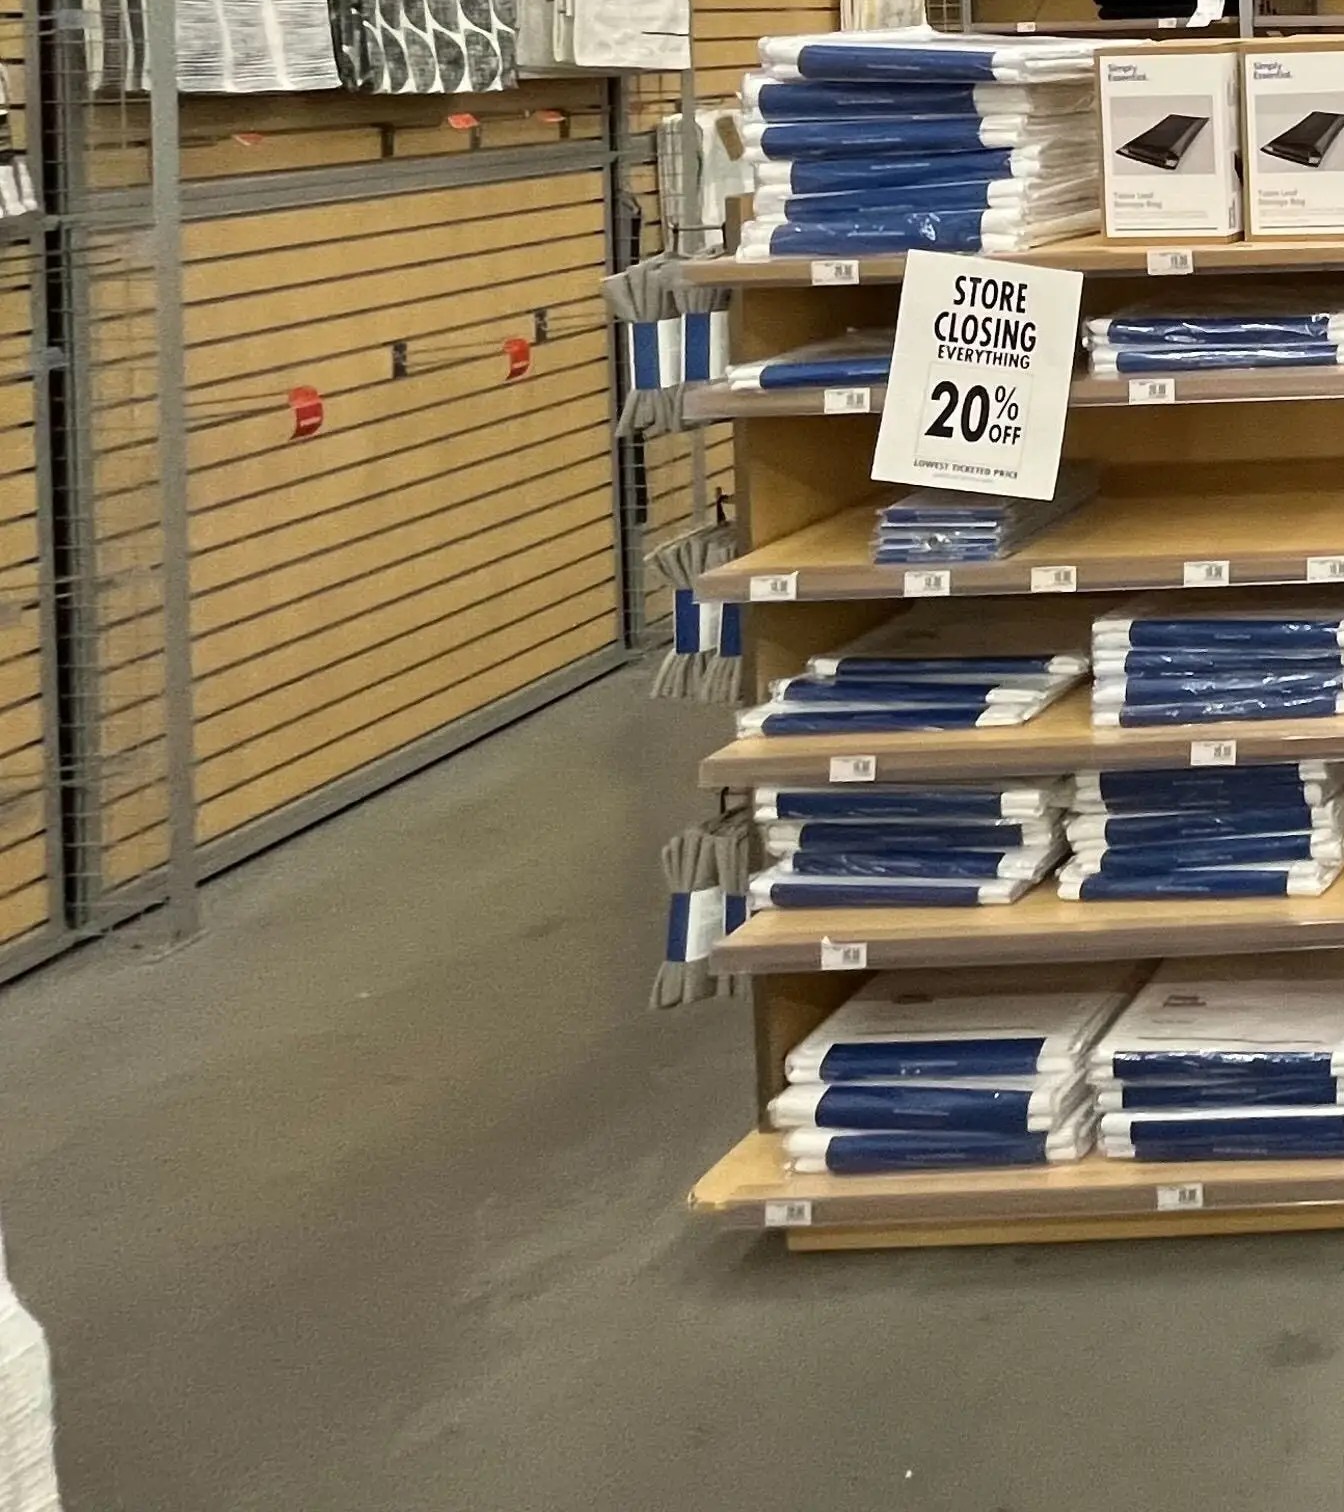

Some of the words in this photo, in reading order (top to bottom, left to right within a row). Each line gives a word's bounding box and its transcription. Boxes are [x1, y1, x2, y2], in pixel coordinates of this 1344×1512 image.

[953, 275, 1028, 314] STORE
[934, 311, 1037, 352] CLOSING
[938, 344, 1030, 370] EVERYTHING
[989, 424, 1022, 445] OFF
